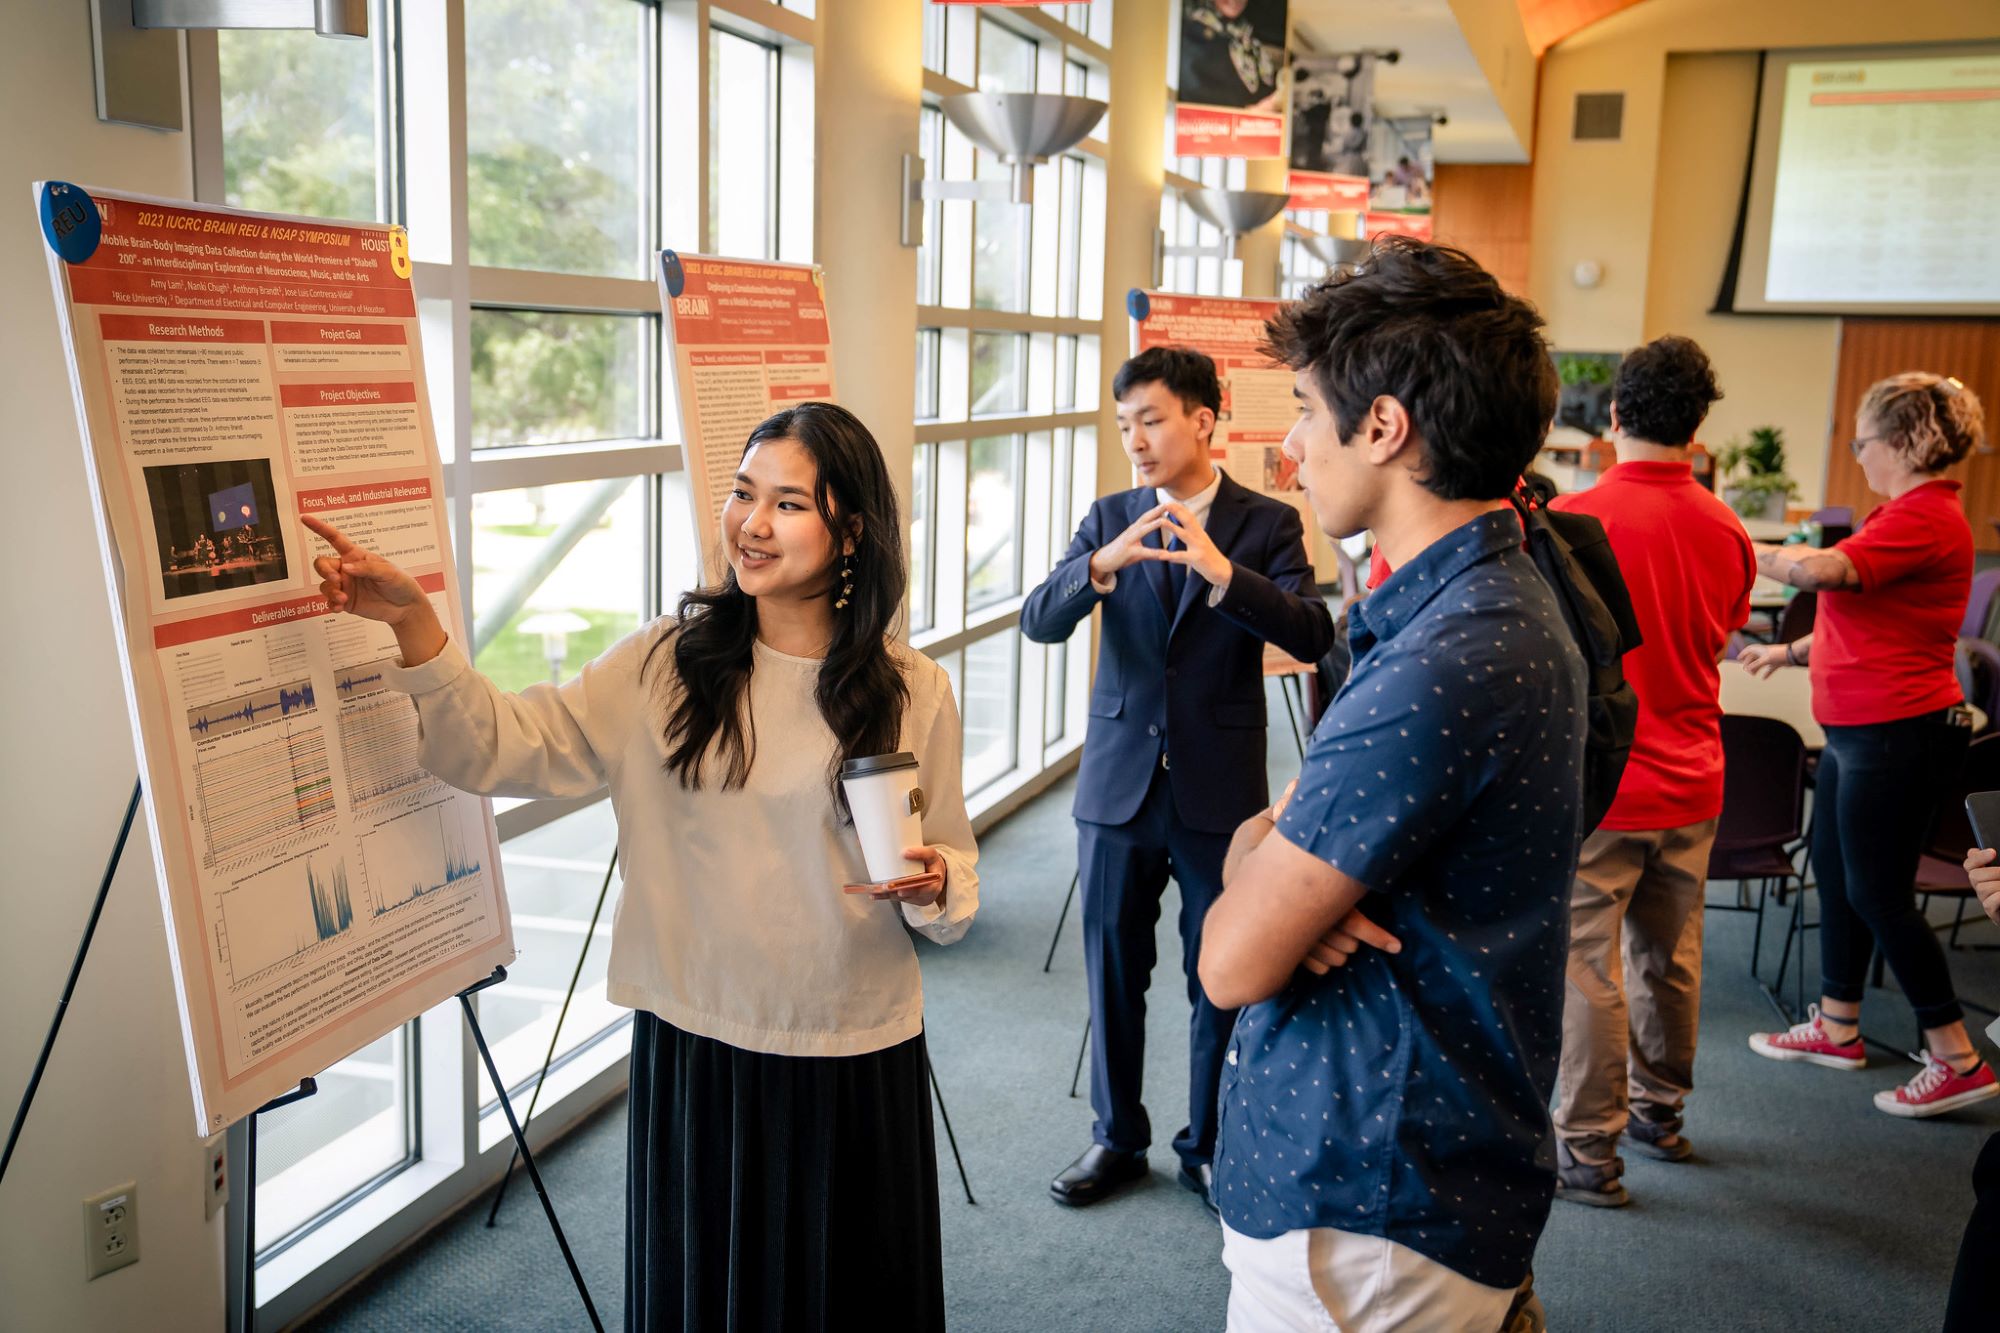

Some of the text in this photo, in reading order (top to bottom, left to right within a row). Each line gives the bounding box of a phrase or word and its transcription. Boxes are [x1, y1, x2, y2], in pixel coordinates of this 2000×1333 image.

[52, 200, 88, 240] REU
[138, 212, 350, 247] 2023 IUCRC BRAIN REU & NSAP SYMPOSIUM
[101, 233, 129, 247] Mobile
[131, 237, 173, 253] Brain-Body
[175, 242, 204, 256] Imaging
[205, 244, 222, 256] Data
[224, 246, 258, 258] Collection
[259, 250, 280, 263] during
[282, 251, 292, 262] the
[294, 253, 313, 263] World
[315, 254, 342, 266] Premiere
[344, 257, 350, 266] of
[360, 238, 390, 252] HOUST
[143, 257, 152, 266] an
[154, 256, 213, 273] Interdisciplinary
[215, 261, 254, 274] Exploration
[256, 265, 262, 274] of
[264, 266, 310, 279] Neuroscience,
[311, 269, 331, 281] Music,
[332, 271, 343, 280] and
[345, 271, 356, 281] the
[357, 272, 369, 282] Arts
[151, 279, 166, 290] Amy
[188, 281, 206, 291] Nanki
[233, 284, 259, 296] Anthony
[298, 288, 308, 297] Luis
[132, 293, 169, 306] University,
[175, 295, 215, 307] Department
[216, 297, 222, 307] of
[224, 298, 252, 308] Electrical
[253, 300, 264, 309] and
[265, 300, 293, 311] Computer
[295, 301, 328, 313] Engineering,
[330, 303, 355, 314] University
[357, 304, 362, 313] of
[363, 305, 384, 313] Houston
[676, 297, 709, 316] BRAIN
[149, 324, 224, 338] Research Methods
[320, 329, 361, 340] Project Goal
[126, 398, 140, 406] During
[320, 389, 380, 402] Project Objectives
[302, 486, 427, 508] Focus, Need, and Industrial Relevance
[252, 606, 296, 624] Deliverables
[297, 603, 311, 614] and
[197, 736, 221, 747] Conductor
[282, 711, 308, 721] Performance
